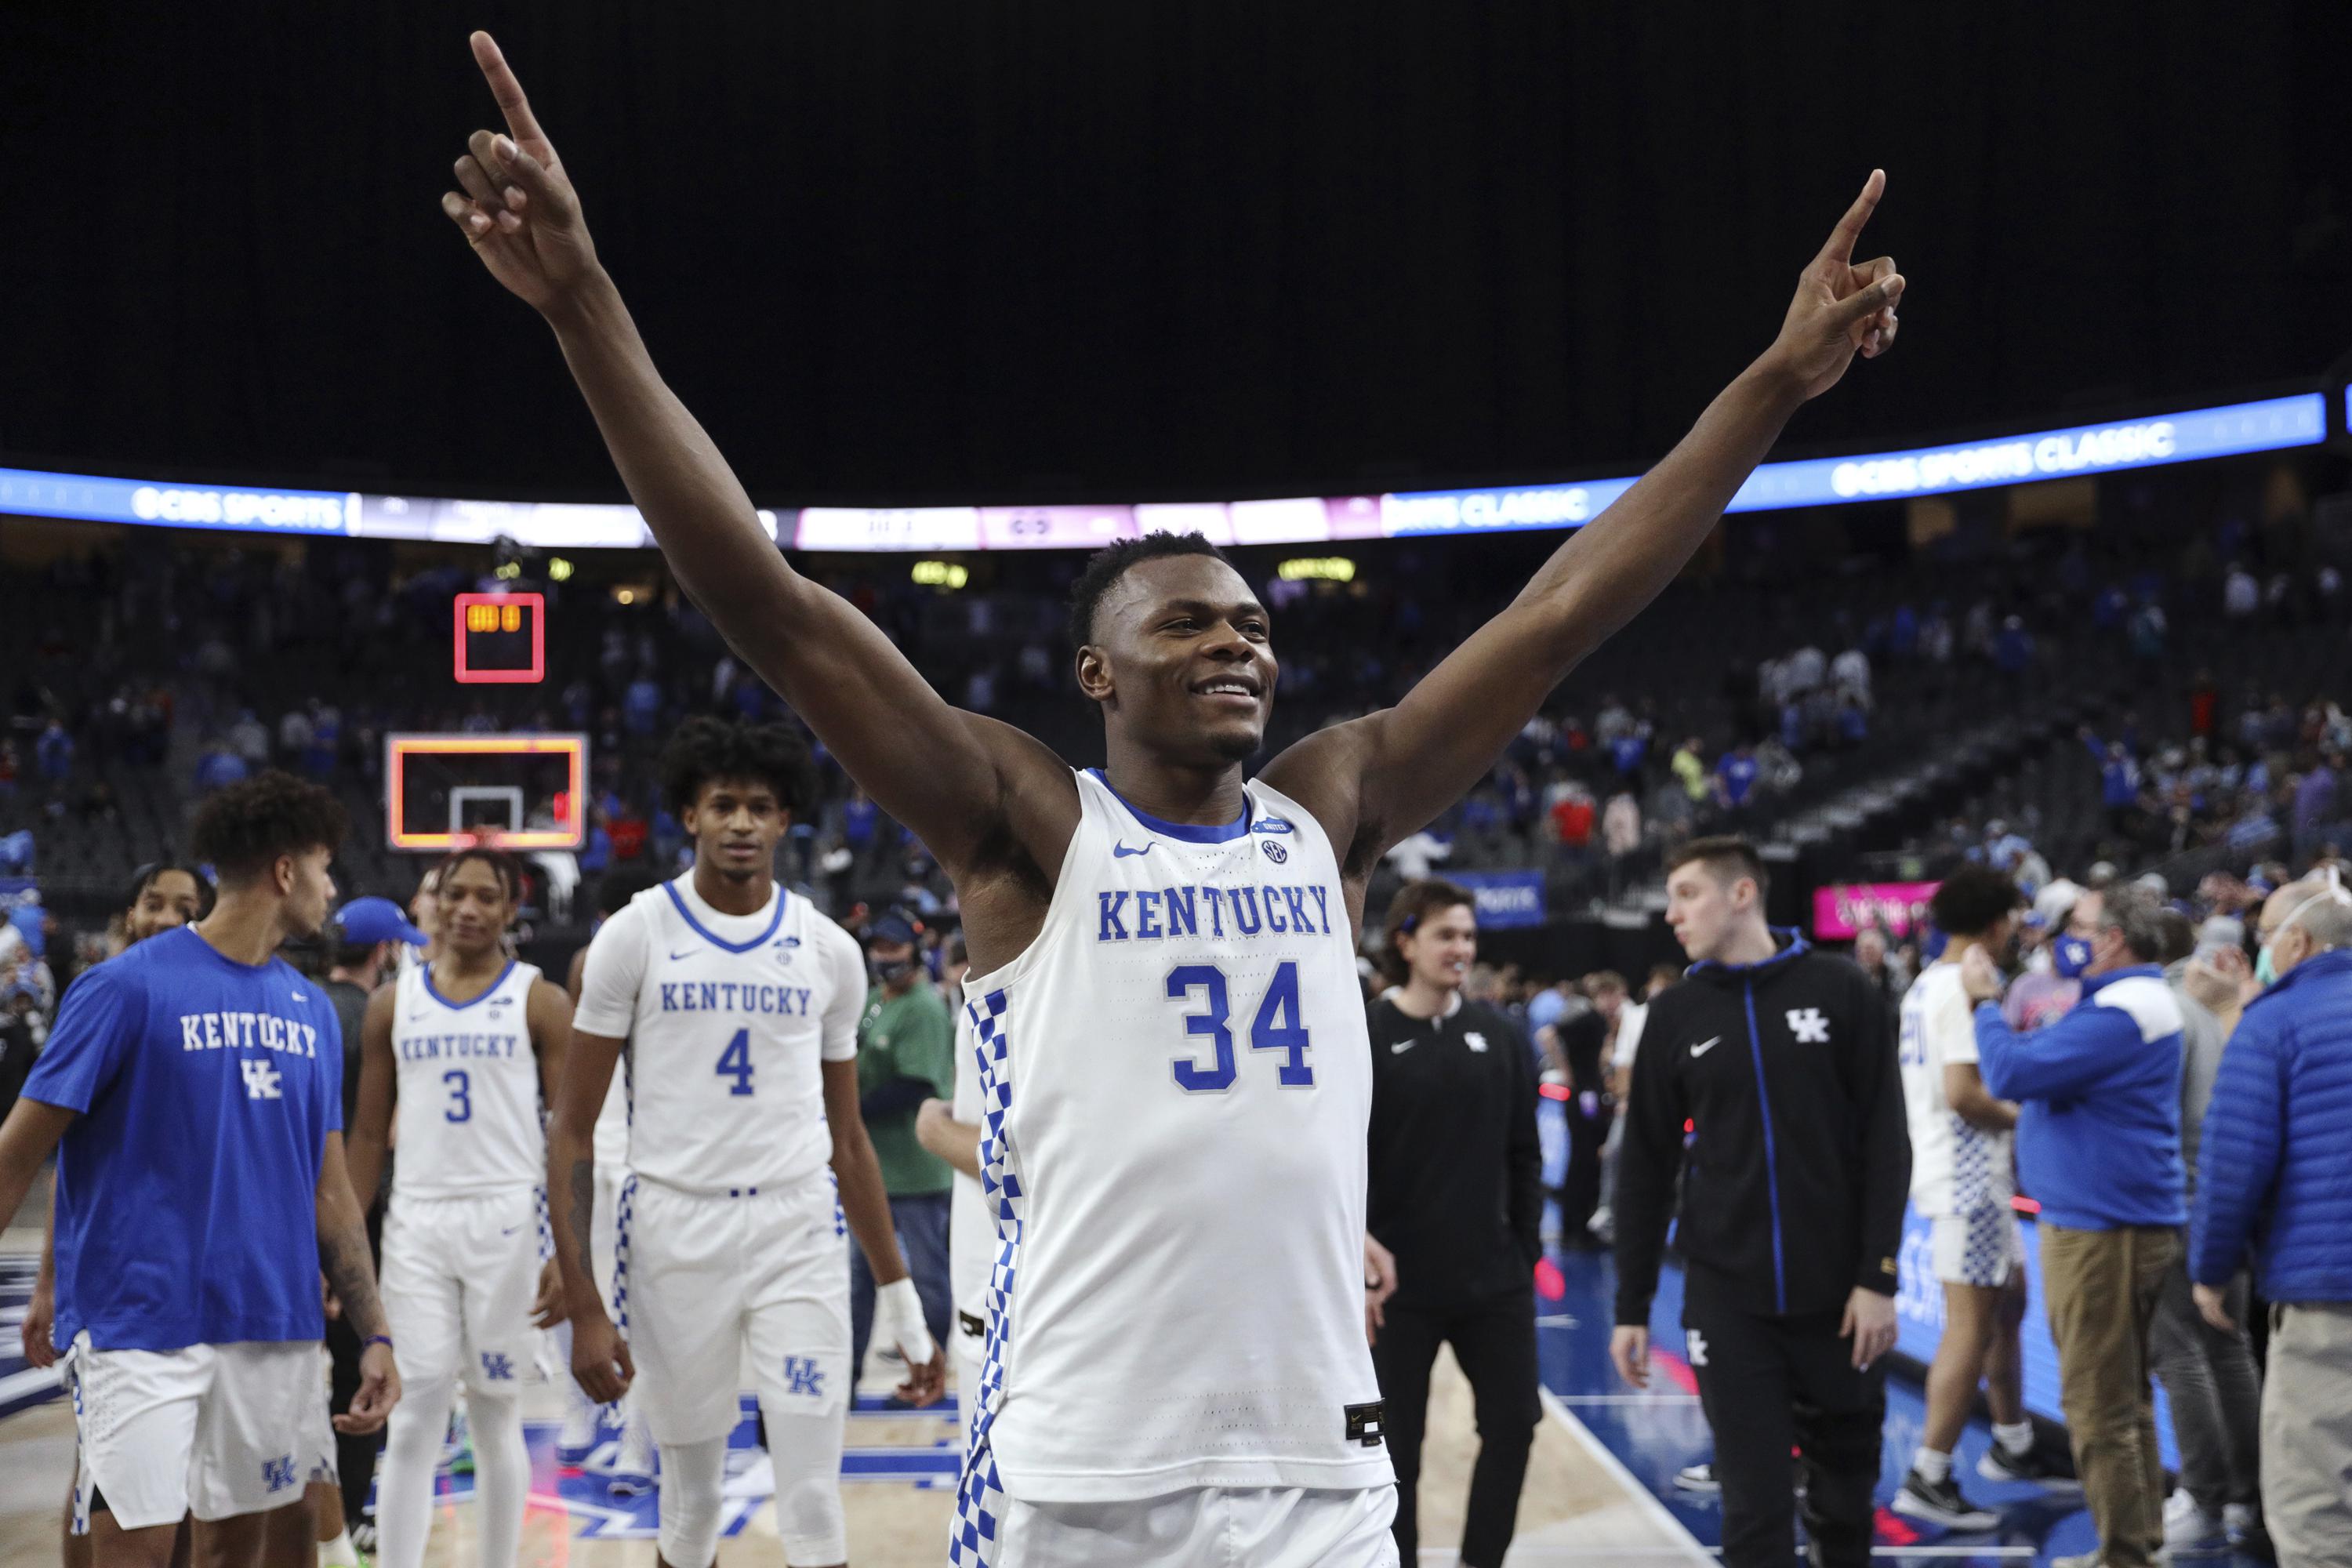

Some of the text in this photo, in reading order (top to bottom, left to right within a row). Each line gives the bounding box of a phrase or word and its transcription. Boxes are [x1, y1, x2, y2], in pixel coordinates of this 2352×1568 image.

[2034, 422, 2176, 472] CLASSIC
[1263, 840, 1287, 863] SEC
[1098, 885, 1332, 944] KENTUCKY
[661, 982, 812, 1016] KENTUCKY
[180, 1011, 316, 1058] KENTUCKY
[401, 1034, 517, 1062] KENTUCKY
[1163, 958, 1317, 1094] 34
[716, 1028, 755, 1097] 4
[442, 1069, 470, 1123] 3
